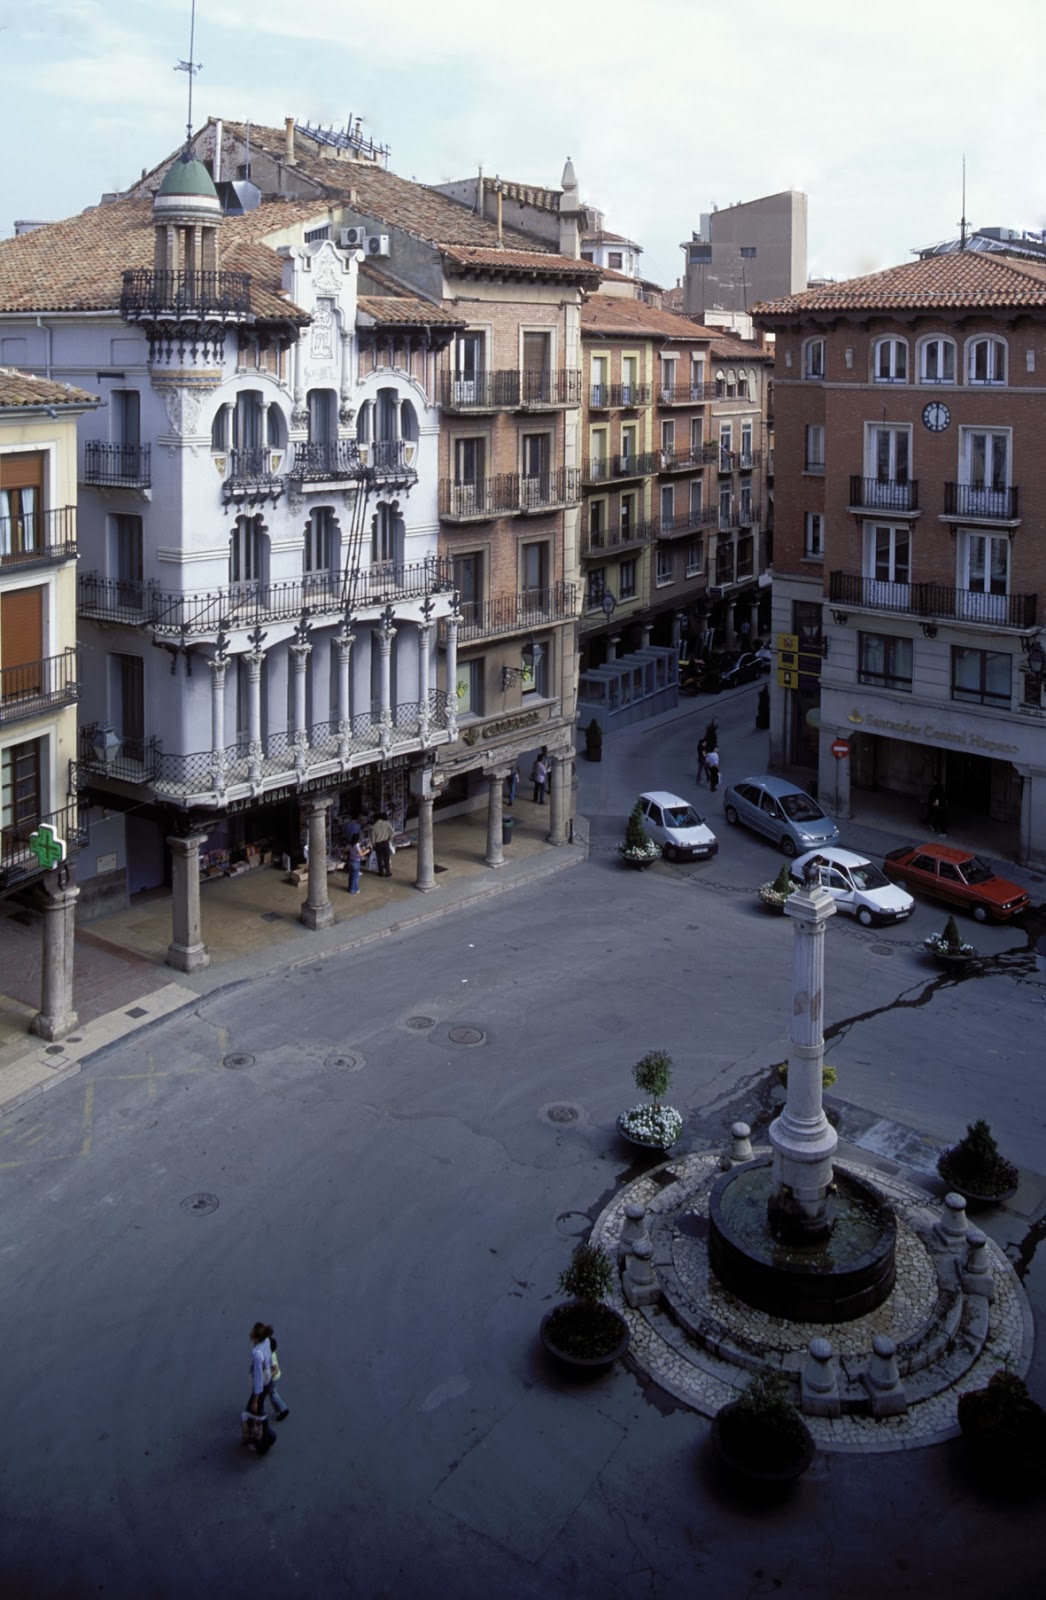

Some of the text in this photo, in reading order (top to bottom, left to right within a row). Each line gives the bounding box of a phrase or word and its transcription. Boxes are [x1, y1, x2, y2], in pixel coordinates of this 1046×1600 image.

[866, 714, 921, 735] Santander
[924, 725, 966, 745] Central
[225, 756, 410, 813] CAJA RURAL PROVINCIAL DE TERUEL
